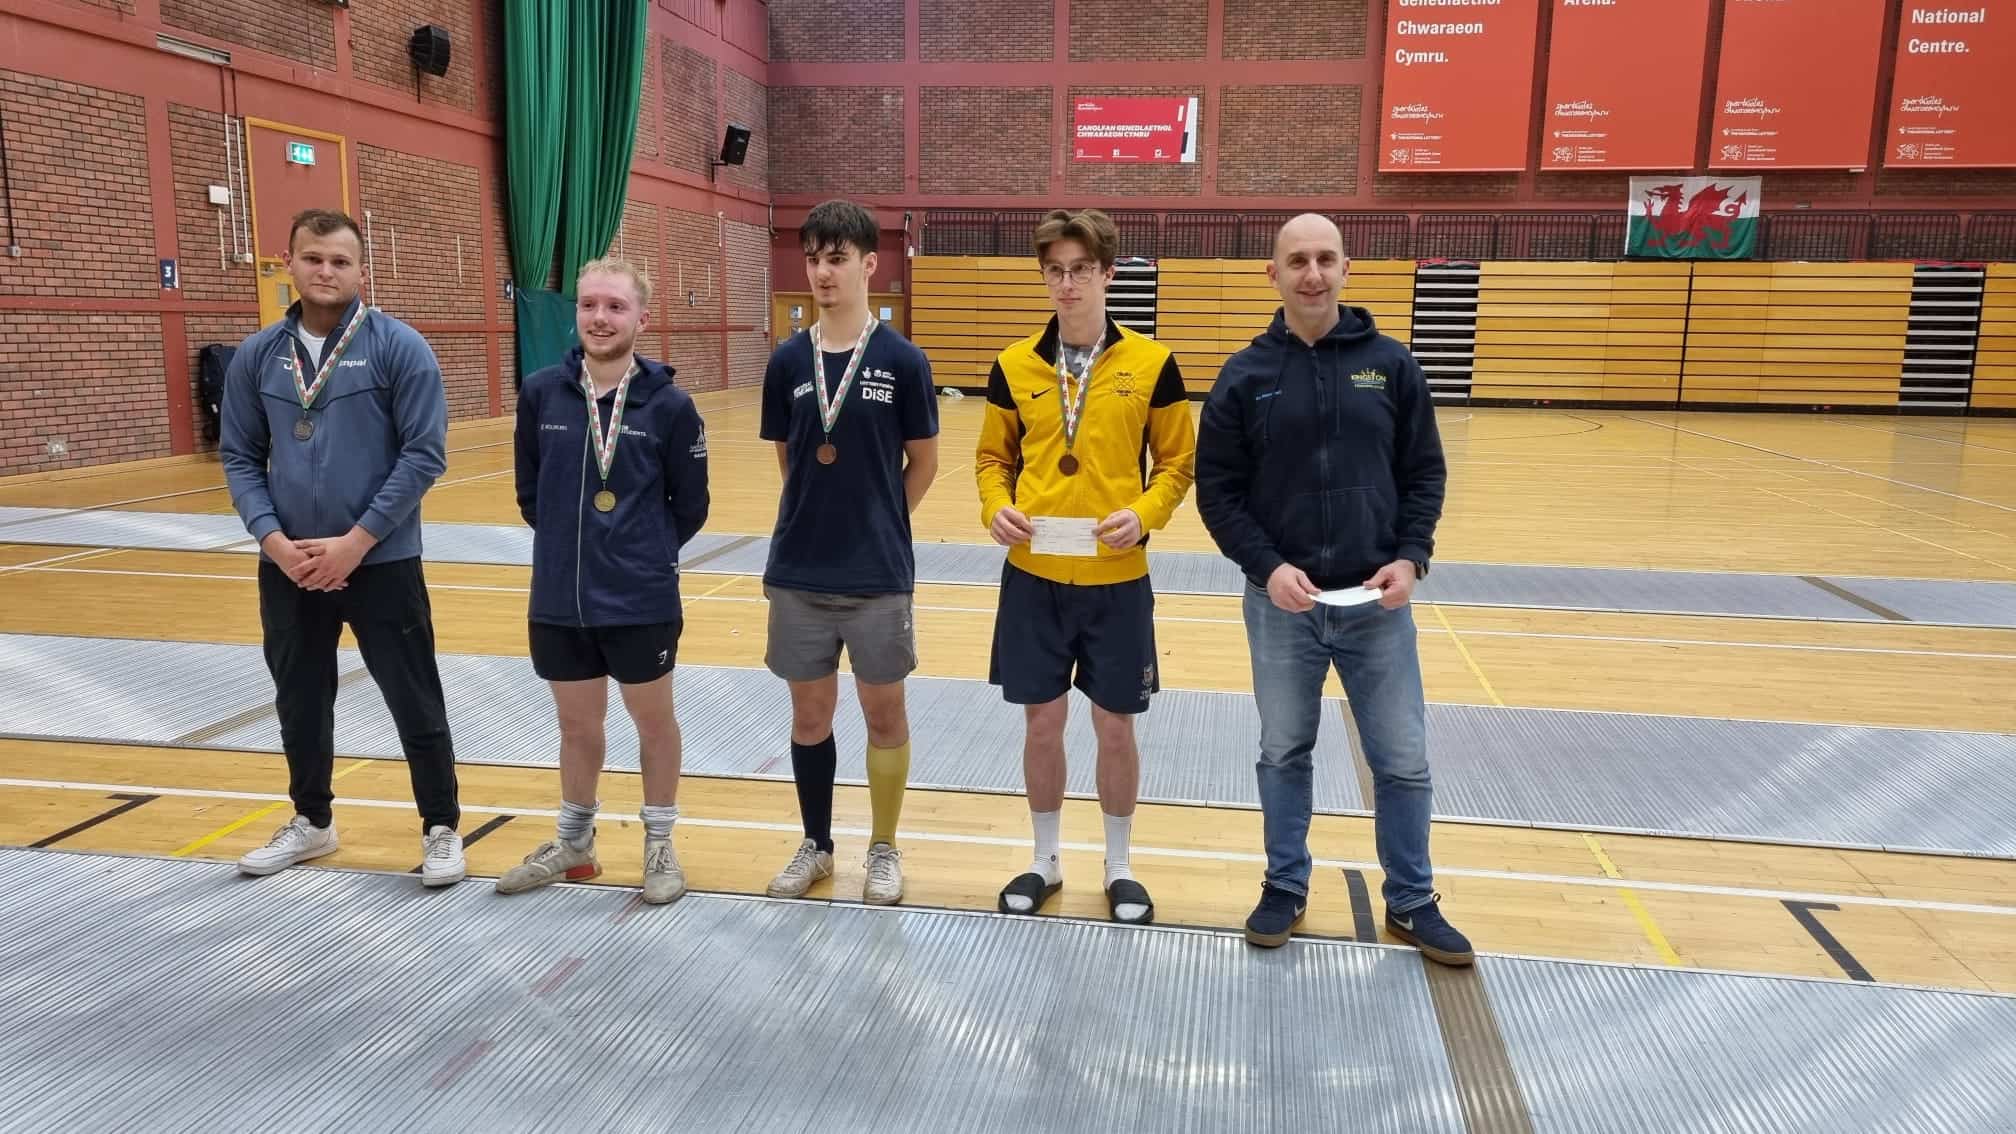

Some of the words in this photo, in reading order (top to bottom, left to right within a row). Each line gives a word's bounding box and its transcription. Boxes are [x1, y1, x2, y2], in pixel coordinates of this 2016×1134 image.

[1911, 8, 1986, 24] National
[1397, 20, 1484, 35] Chwaraeon
[1908, 38, 1970, 54] Centre.
[1395, 49, 1449, 65] Cymru.
[862, 387, 894, 404] DiSE
